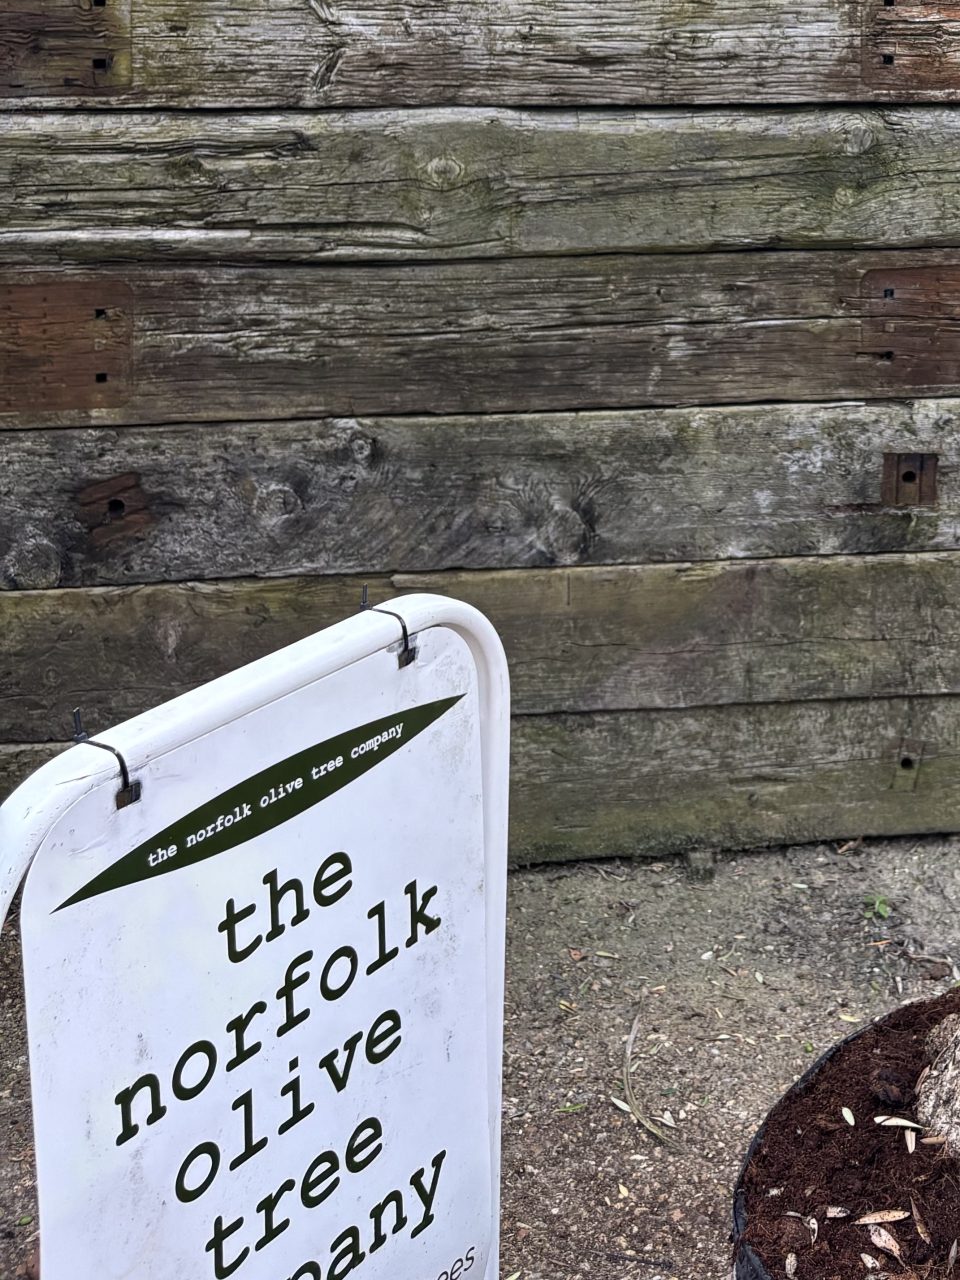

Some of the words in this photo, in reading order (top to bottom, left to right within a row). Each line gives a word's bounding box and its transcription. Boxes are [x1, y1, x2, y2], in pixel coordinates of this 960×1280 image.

[147, 843, 178, 867] the
[186, 803, 252, 848] norfolk
[259, 777, 304, 808] olive
[311, 755, 344, 780] tree
[350, 722, 404, 759] company
[217, 851, 353, 964] the
[115, 879, 442, 1147] norfolk
[175, 1009, 402, 1204] olive
[205, 1116, 383, 1280] tree
[286, 1149, 447, 1280] any
